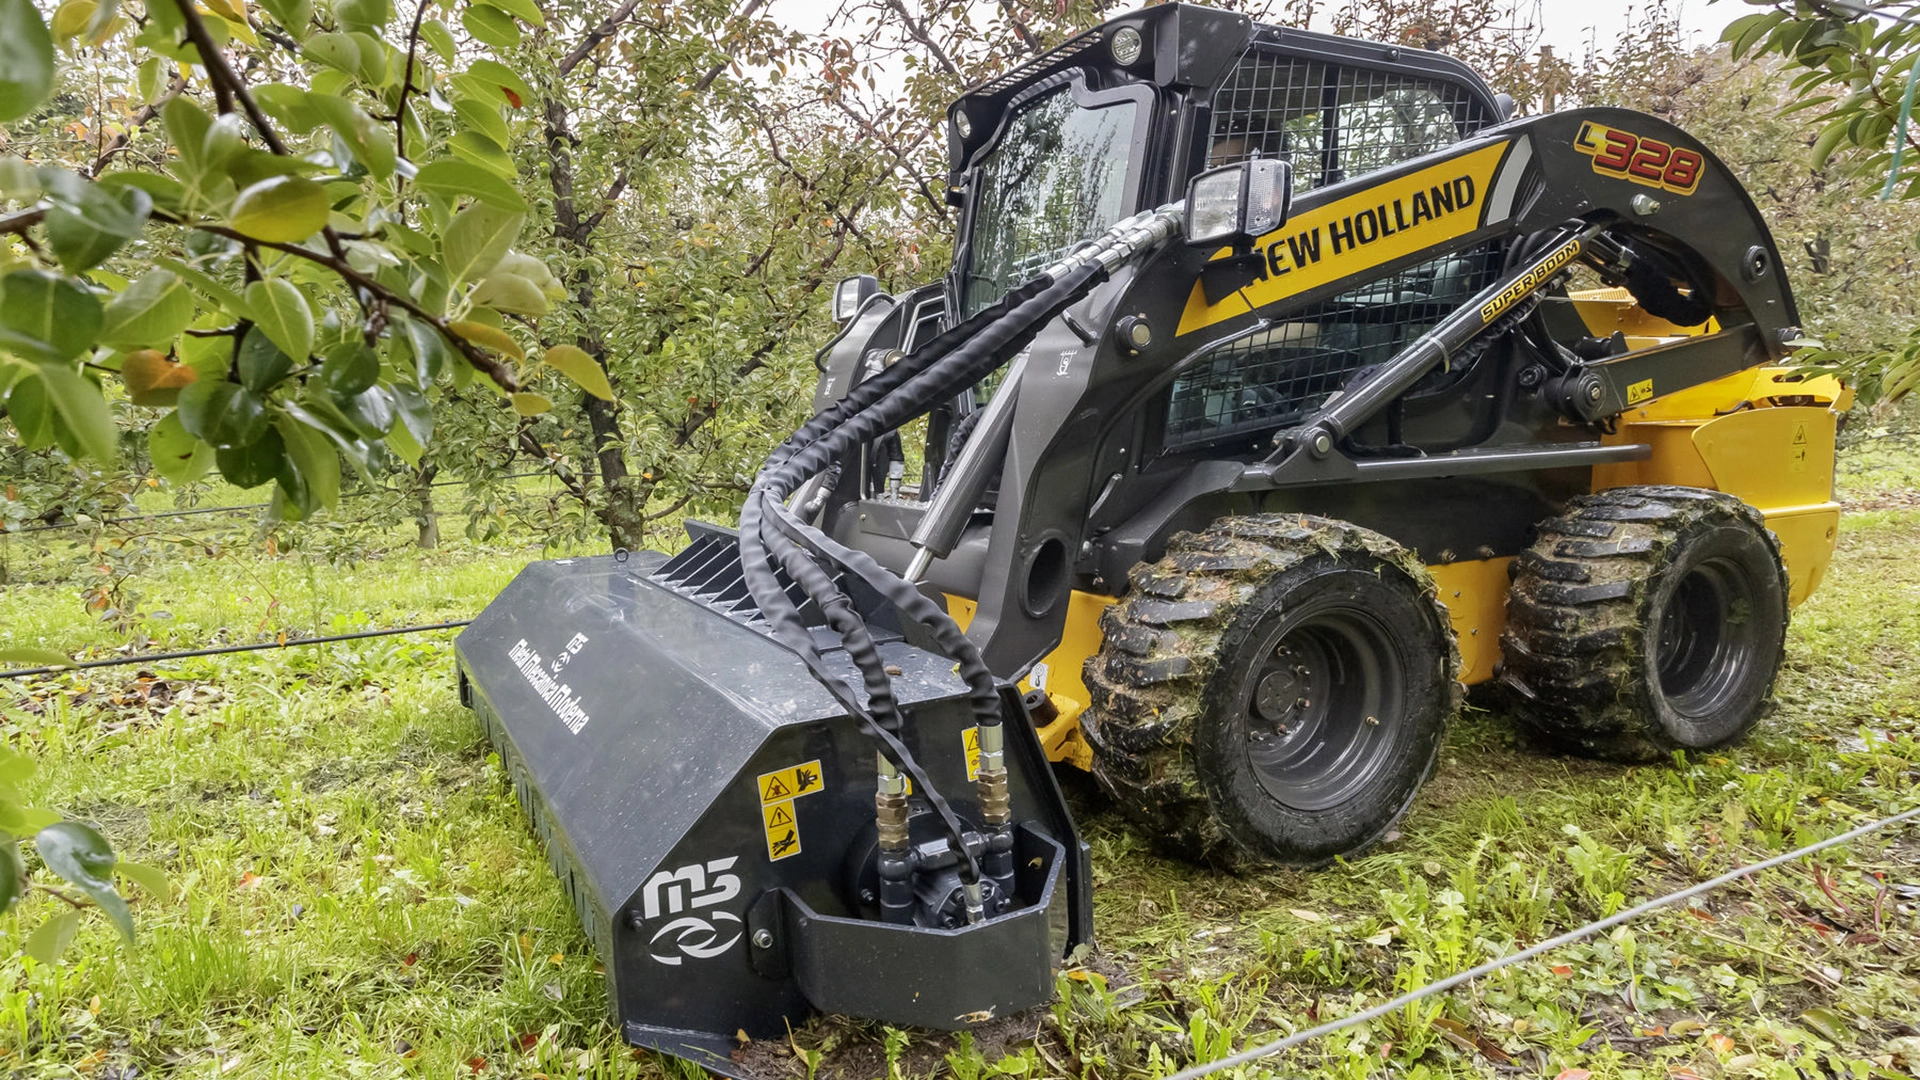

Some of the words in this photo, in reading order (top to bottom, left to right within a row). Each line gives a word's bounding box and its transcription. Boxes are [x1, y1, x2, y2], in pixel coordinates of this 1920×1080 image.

[1328, 174, 1476, 255] HOLLAND
[1482, 275, 1535, 321] SUPER
[1535, 242, 1579, 280] BOOM
[547, 683, 590, 735] Moderna
